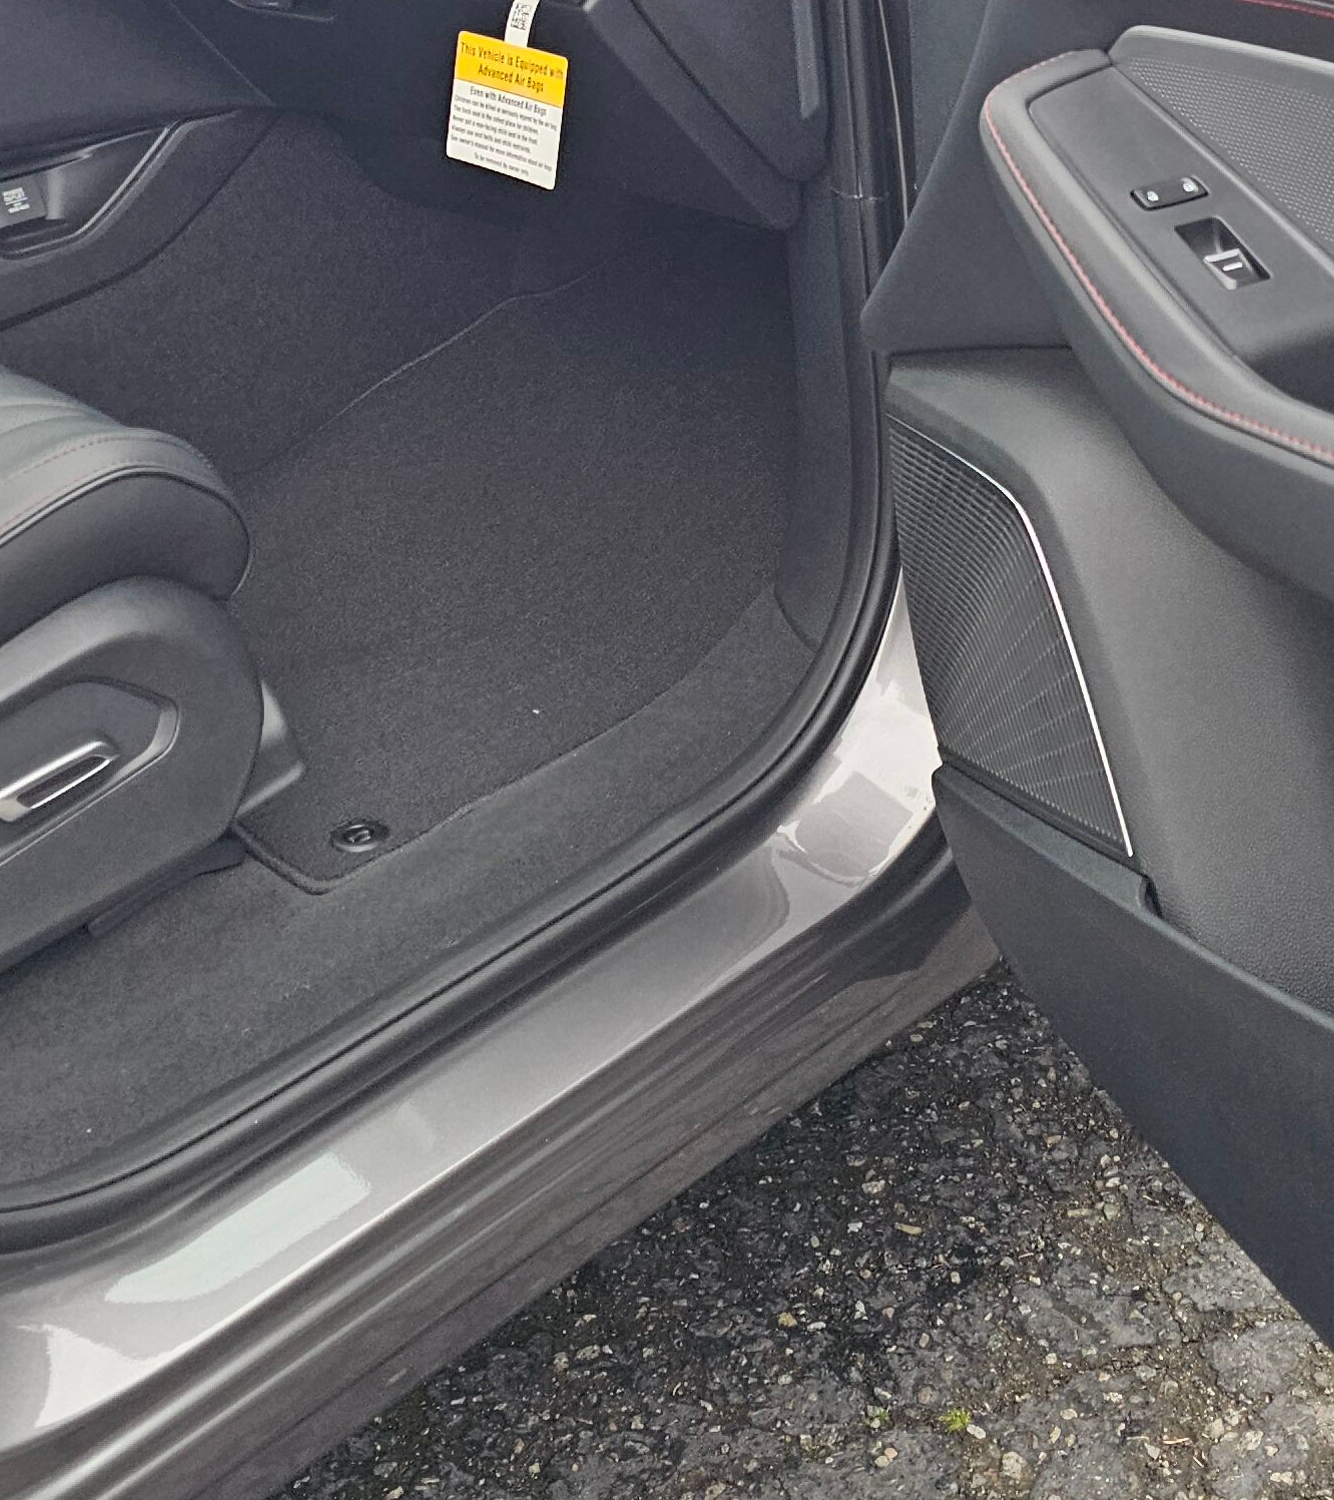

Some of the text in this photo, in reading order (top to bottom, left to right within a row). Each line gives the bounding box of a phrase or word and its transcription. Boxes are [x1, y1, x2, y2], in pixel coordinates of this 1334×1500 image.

[460, 41, 476, 56] This
[478, 46, 506, 63] Vehicle
[515, 56, 548, 76] Equipped
[478, 63, 544, 93] Advanced Air Bags
[470, 86, 483, 97] Even
[485, 91, 496, 101] with
[498, 94, 524, 109] Advanced
